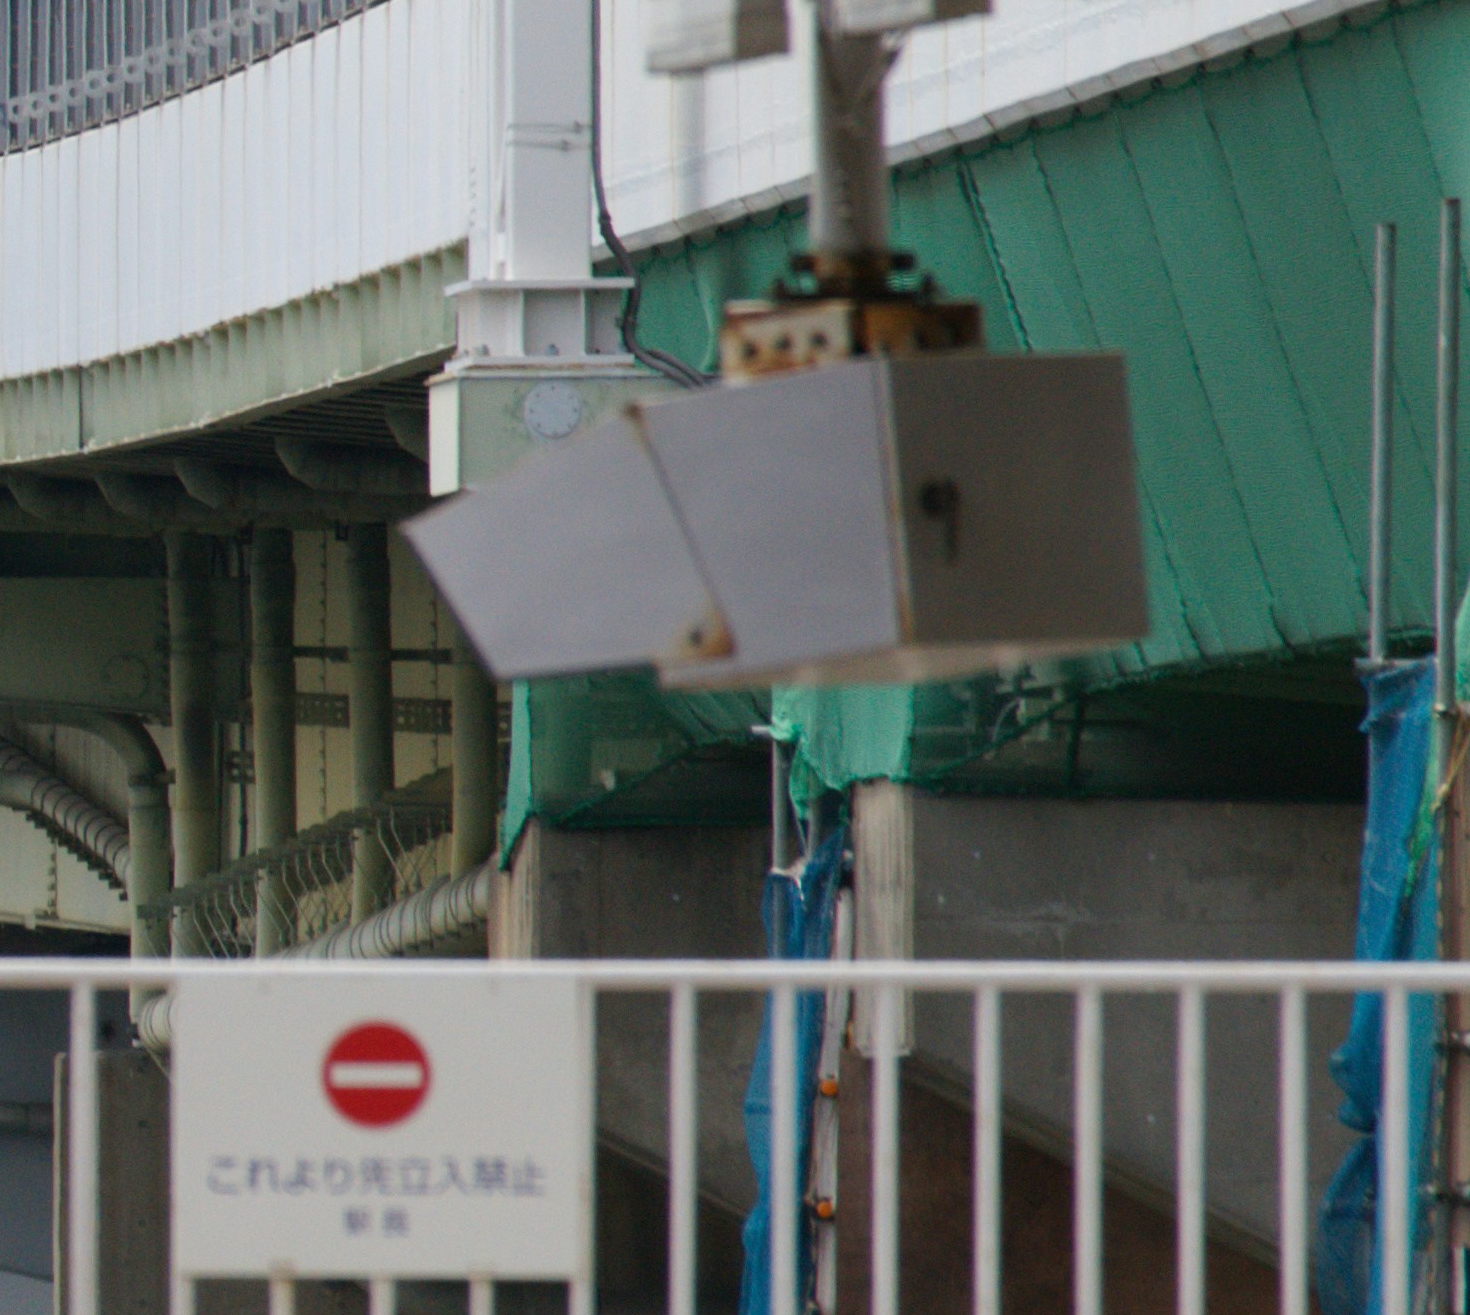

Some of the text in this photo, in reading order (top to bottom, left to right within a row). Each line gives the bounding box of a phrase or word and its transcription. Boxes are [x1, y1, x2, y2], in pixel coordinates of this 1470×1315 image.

[206, 1153, 546, 1197] これより先立入禁止
